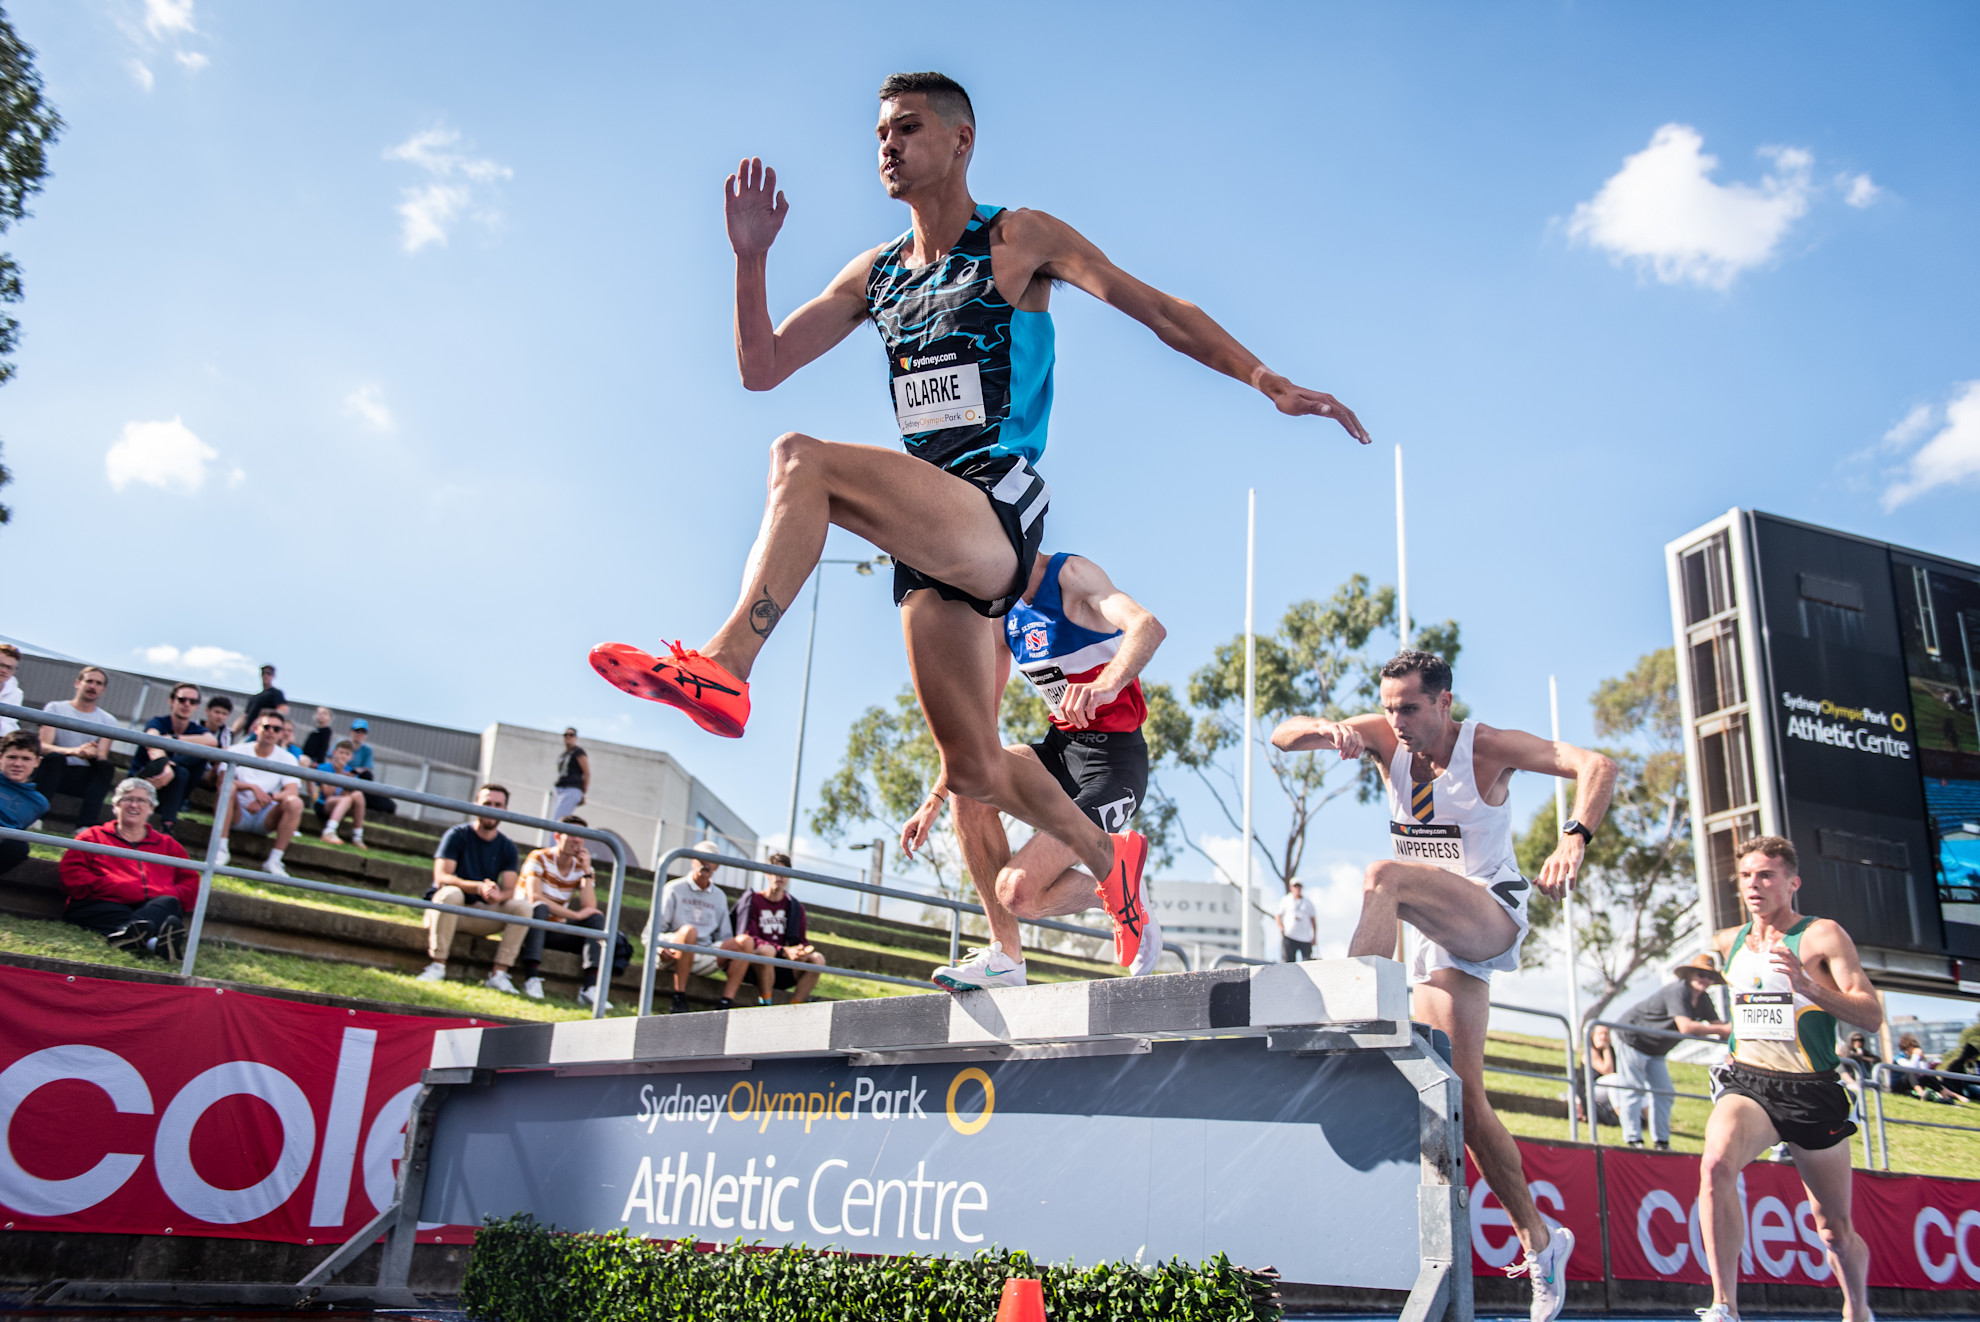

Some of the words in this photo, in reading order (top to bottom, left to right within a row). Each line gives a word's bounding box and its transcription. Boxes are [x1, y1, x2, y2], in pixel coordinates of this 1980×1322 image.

[913, 352, 957, 369] sydney.com
[905, 374, 961, 408] CLARKE
[1782, 691, 1888, 726] SydneyOlympicPark
[1076, 732, 1109, 744] PRO
[1786, 714, 1855, 749] Athletic
[1855, 727, 1911, 760] Centre
[1411, 827, 1447, 836] sydney.com
[1395, 839, 1460, 860] NIPPERESS
[1150, 899, 1232, 915] OVOTEL
[1742, 1008, 1783, 1025] TRIPPAS
[637, 1075, 928, 1134] SydneyOlympicPark
[0, 1026, 421, 1229] col
[620, 1151, 800, 1233] Athletic
[807, 1158, 989, 1244] Centre
